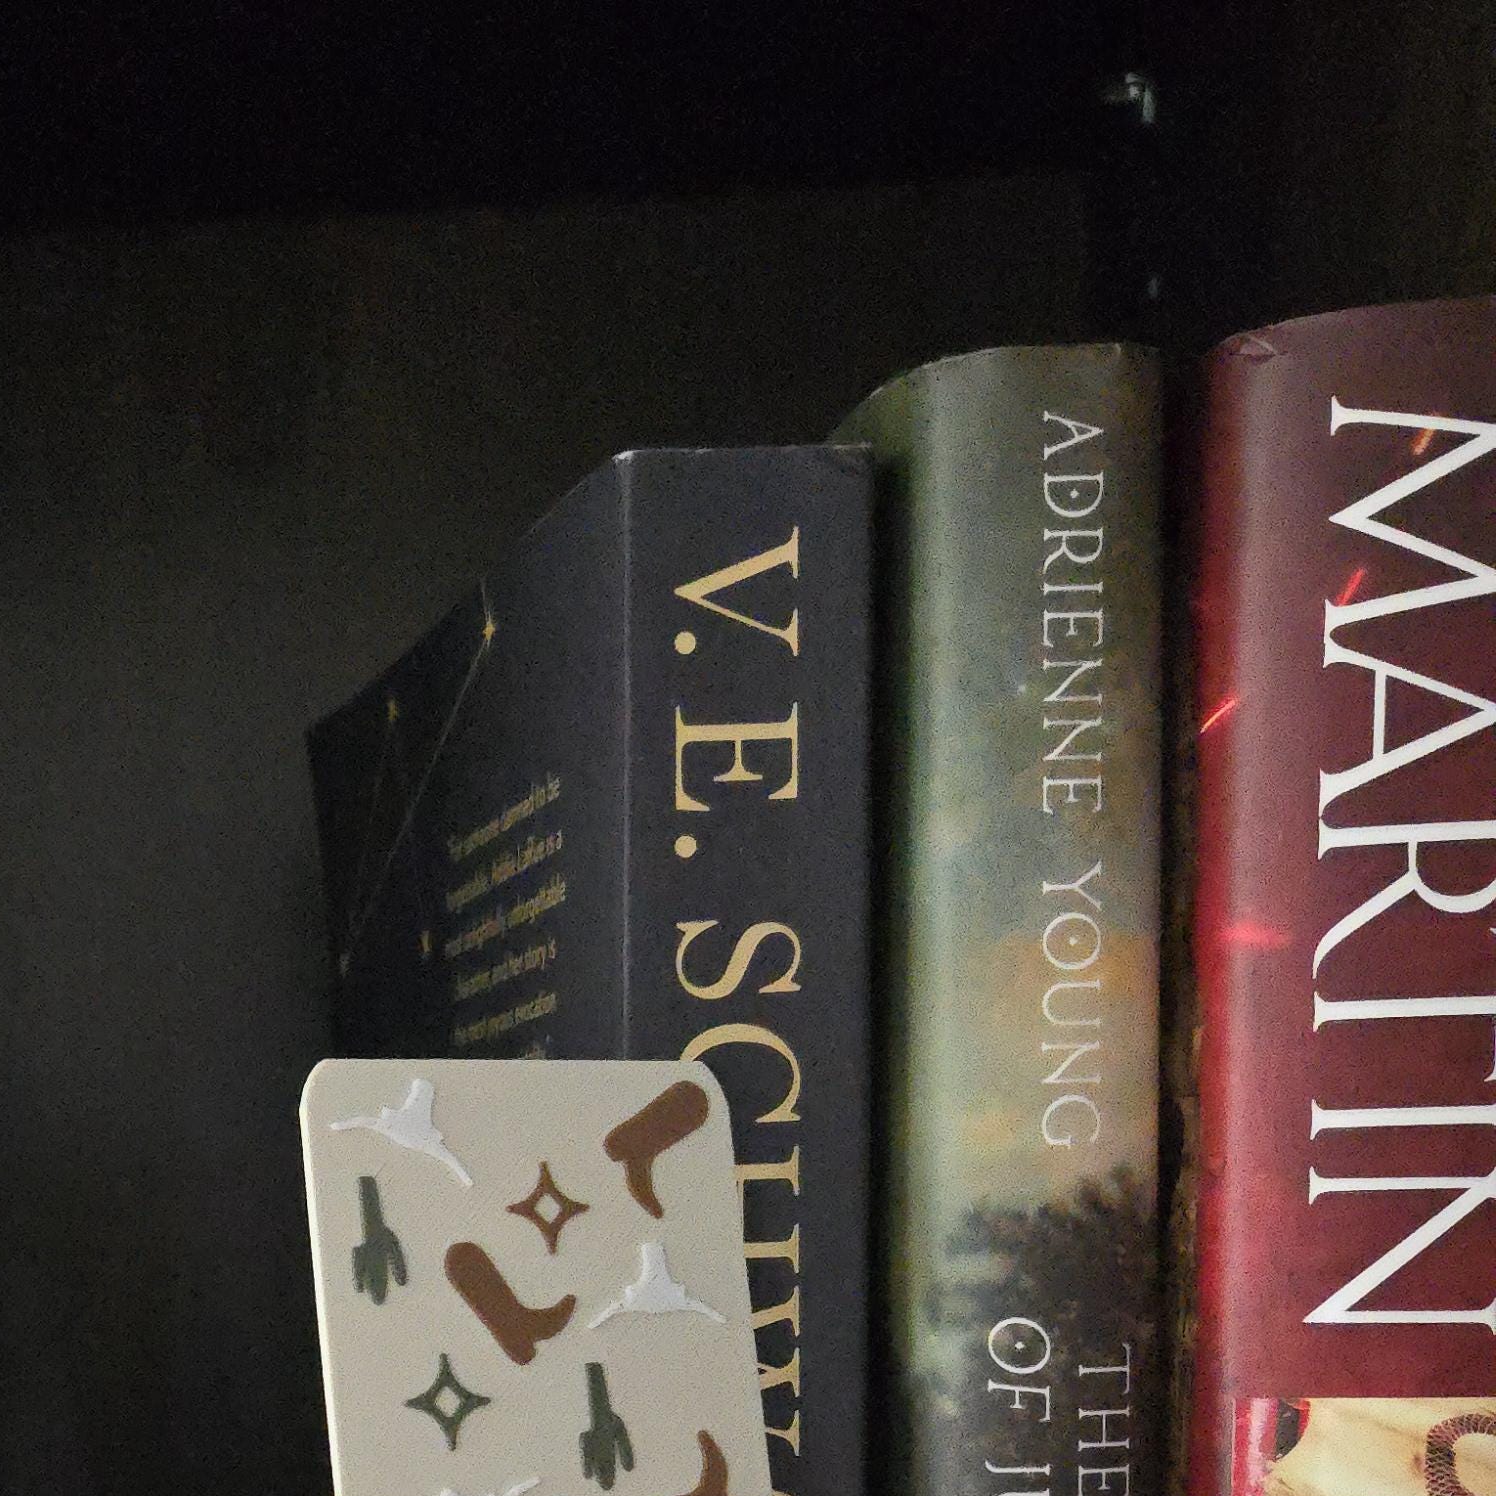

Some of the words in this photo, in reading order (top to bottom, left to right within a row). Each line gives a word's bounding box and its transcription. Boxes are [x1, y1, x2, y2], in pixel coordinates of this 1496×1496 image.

[1040, 410, 1104, 815] ADRIENNE
[1040, 861, 1104, 1149] YOUNG
[1302, 394, 1496, 1335] MARTIN
[987, 1315, 1052, 1422] OF
